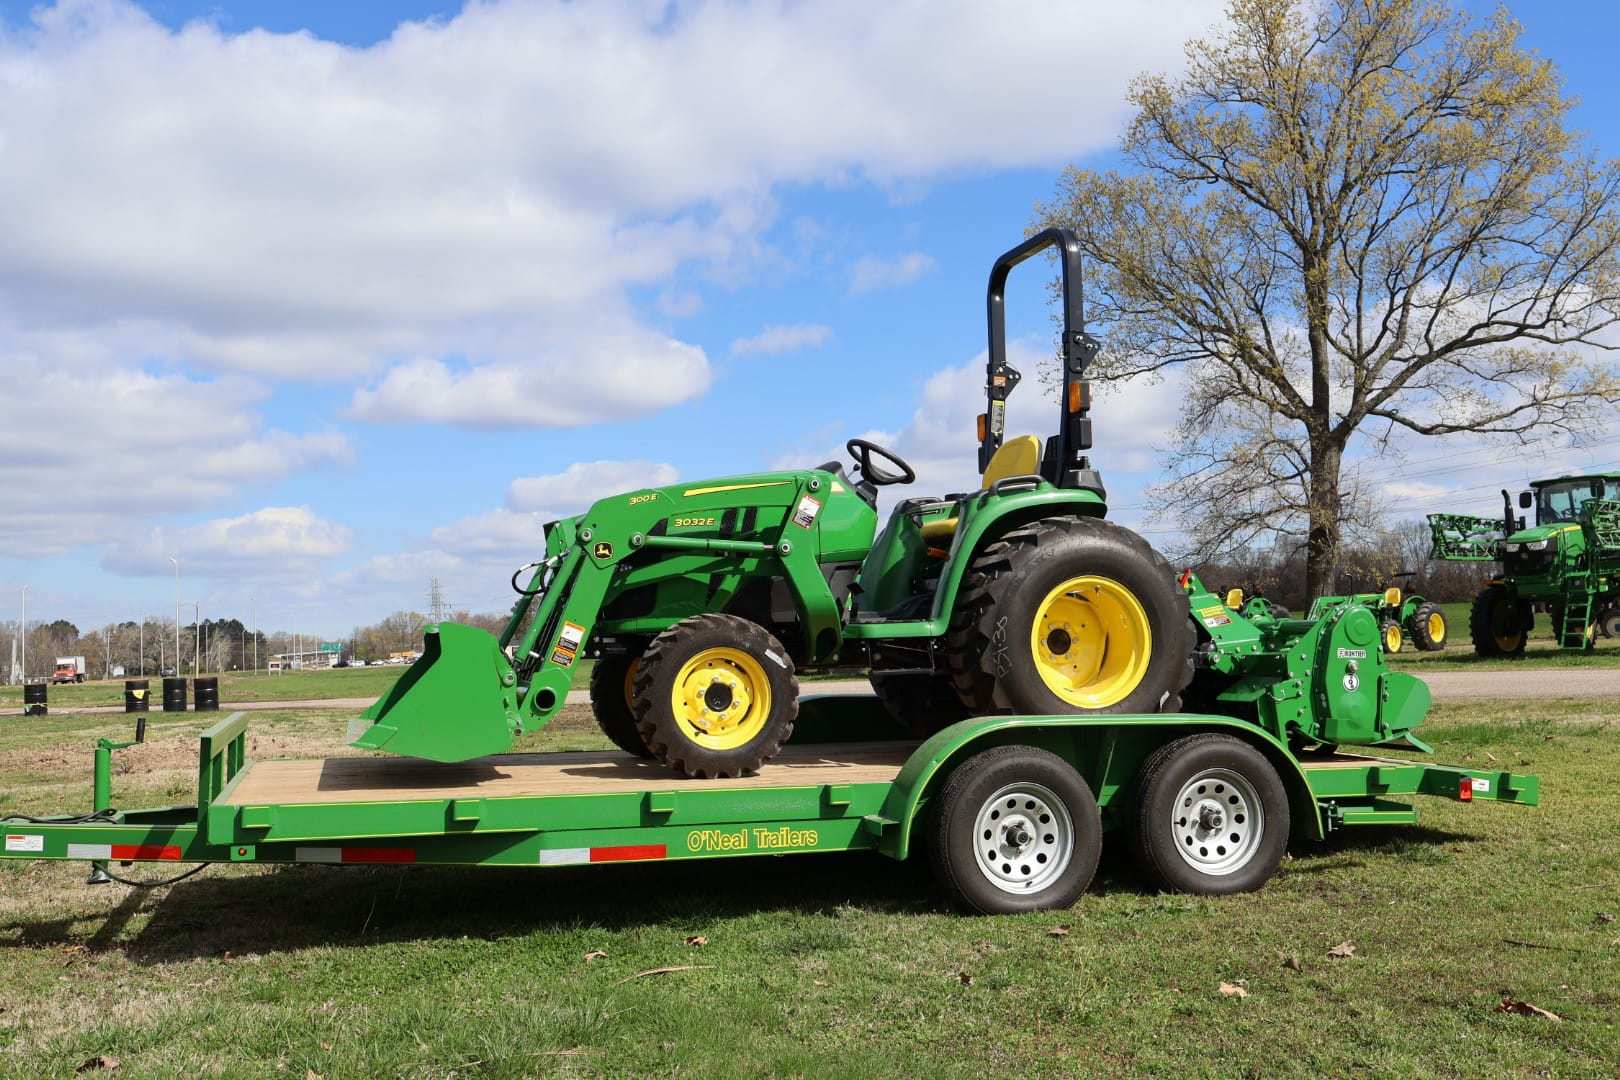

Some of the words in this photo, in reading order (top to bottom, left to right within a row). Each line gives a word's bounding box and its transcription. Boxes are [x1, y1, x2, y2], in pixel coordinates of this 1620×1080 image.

[673, 517, 715, 528] 3032E
[687, 829, 748, 852] O'Neal
[753, 827, 818, 849] Trailers
